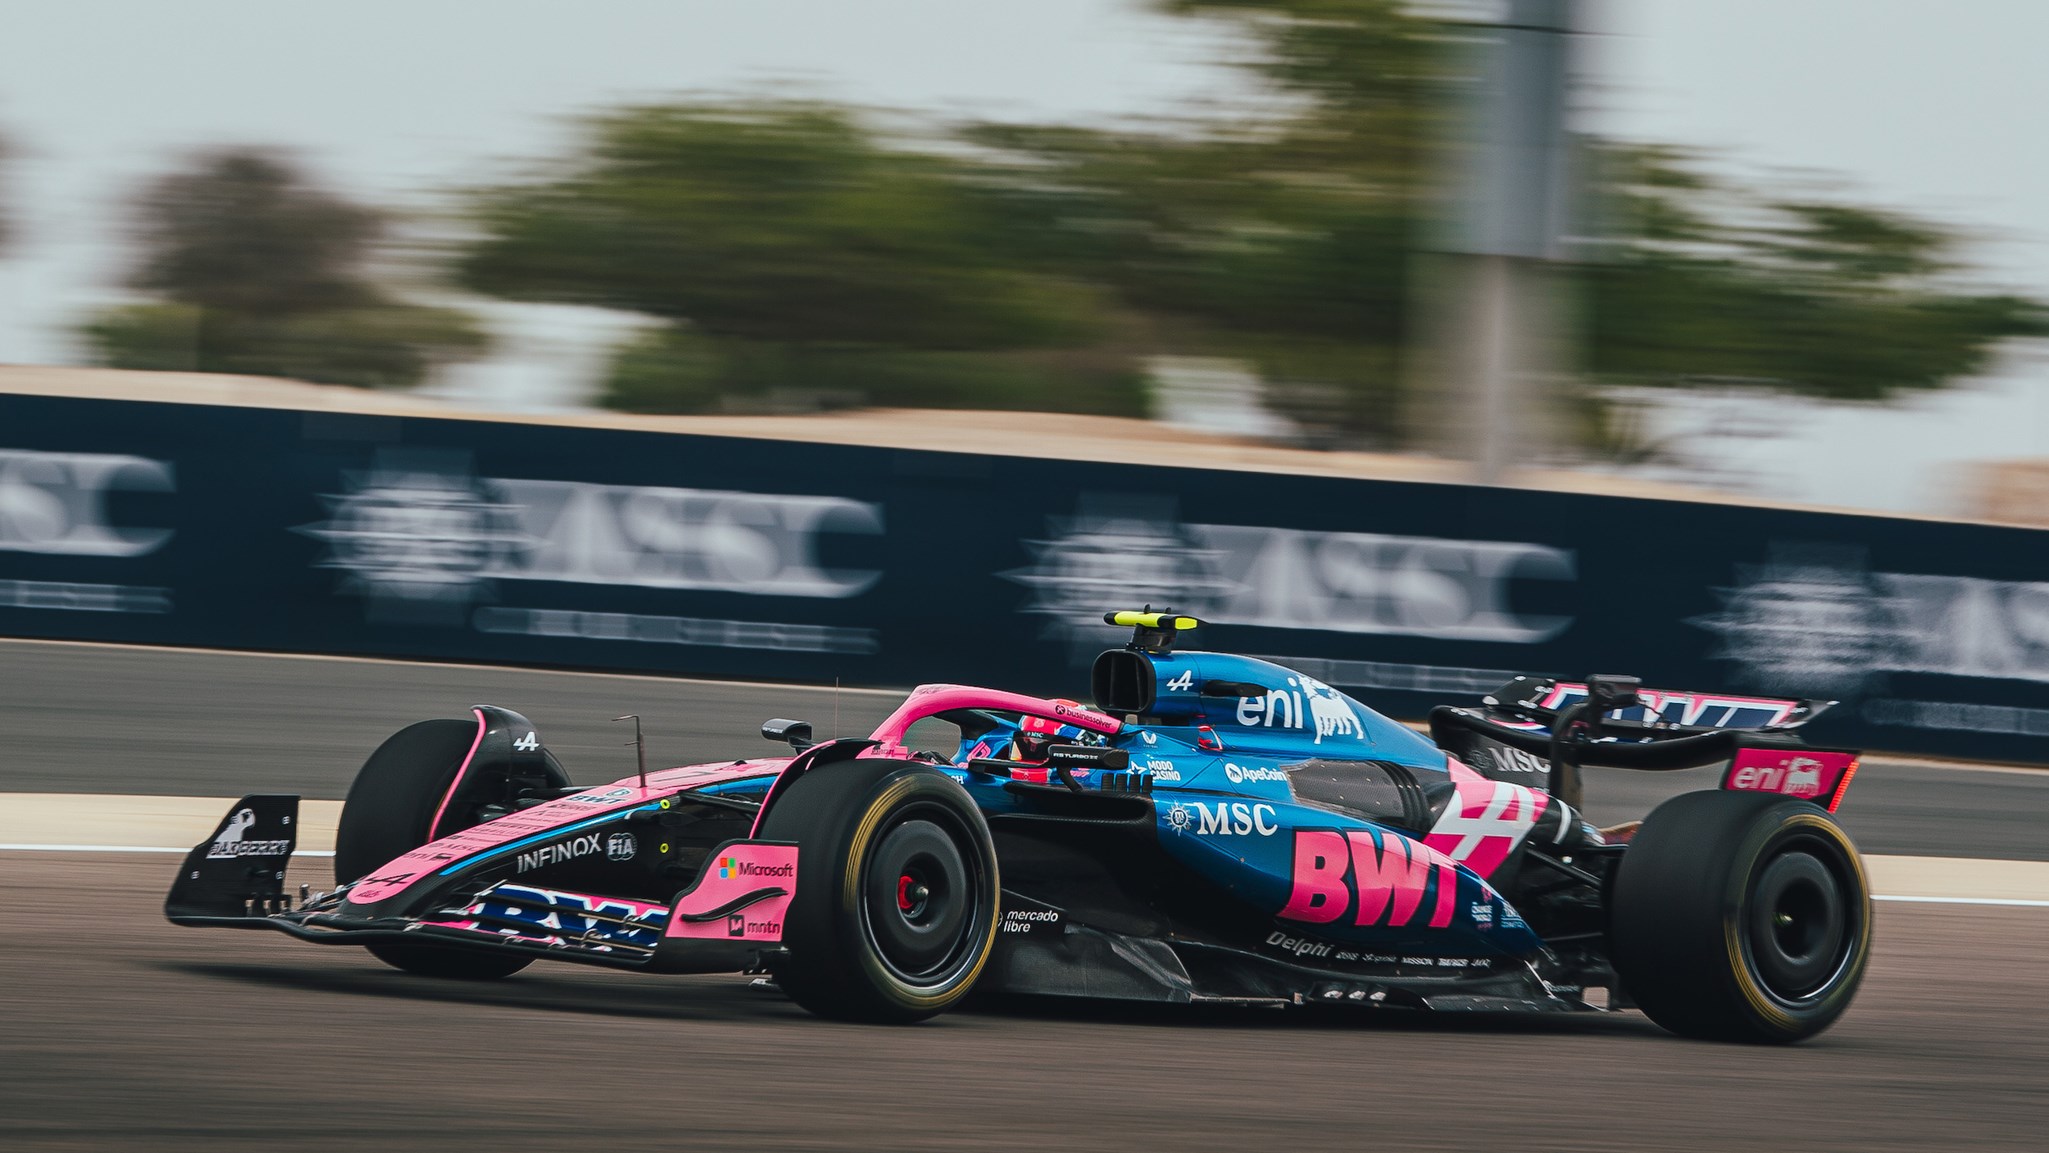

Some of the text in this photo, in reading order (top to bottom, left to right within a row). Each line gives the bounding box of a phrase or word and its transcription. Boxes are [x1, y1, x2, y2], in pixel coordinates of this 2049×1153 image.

[1236, 677, 1304, 729] eni
[1066, 707, 1113, 728] businessolver
[1147, 760, 1174, 771] MODO
[1488, 747, 1551, 773] MSC
[1150, 769, 1181, 782] CASINO
[1242, 767, 1288, 783] ApeCoin
[1733, 759, 1790, 790] eni
[1197, 802, 1278, 836] MSC
[517, 832, 602, 874] INFINOX
[739, 862, 793, 878] Microsoft
[1275, 829, 1458, 929] BWT
[1003, 920, 1031, 933] libre
[1007, 910, 1058, 922] mercado
[747, 921, 780, 934] mntn
[1266, 931, 1335, 956] Delphi
